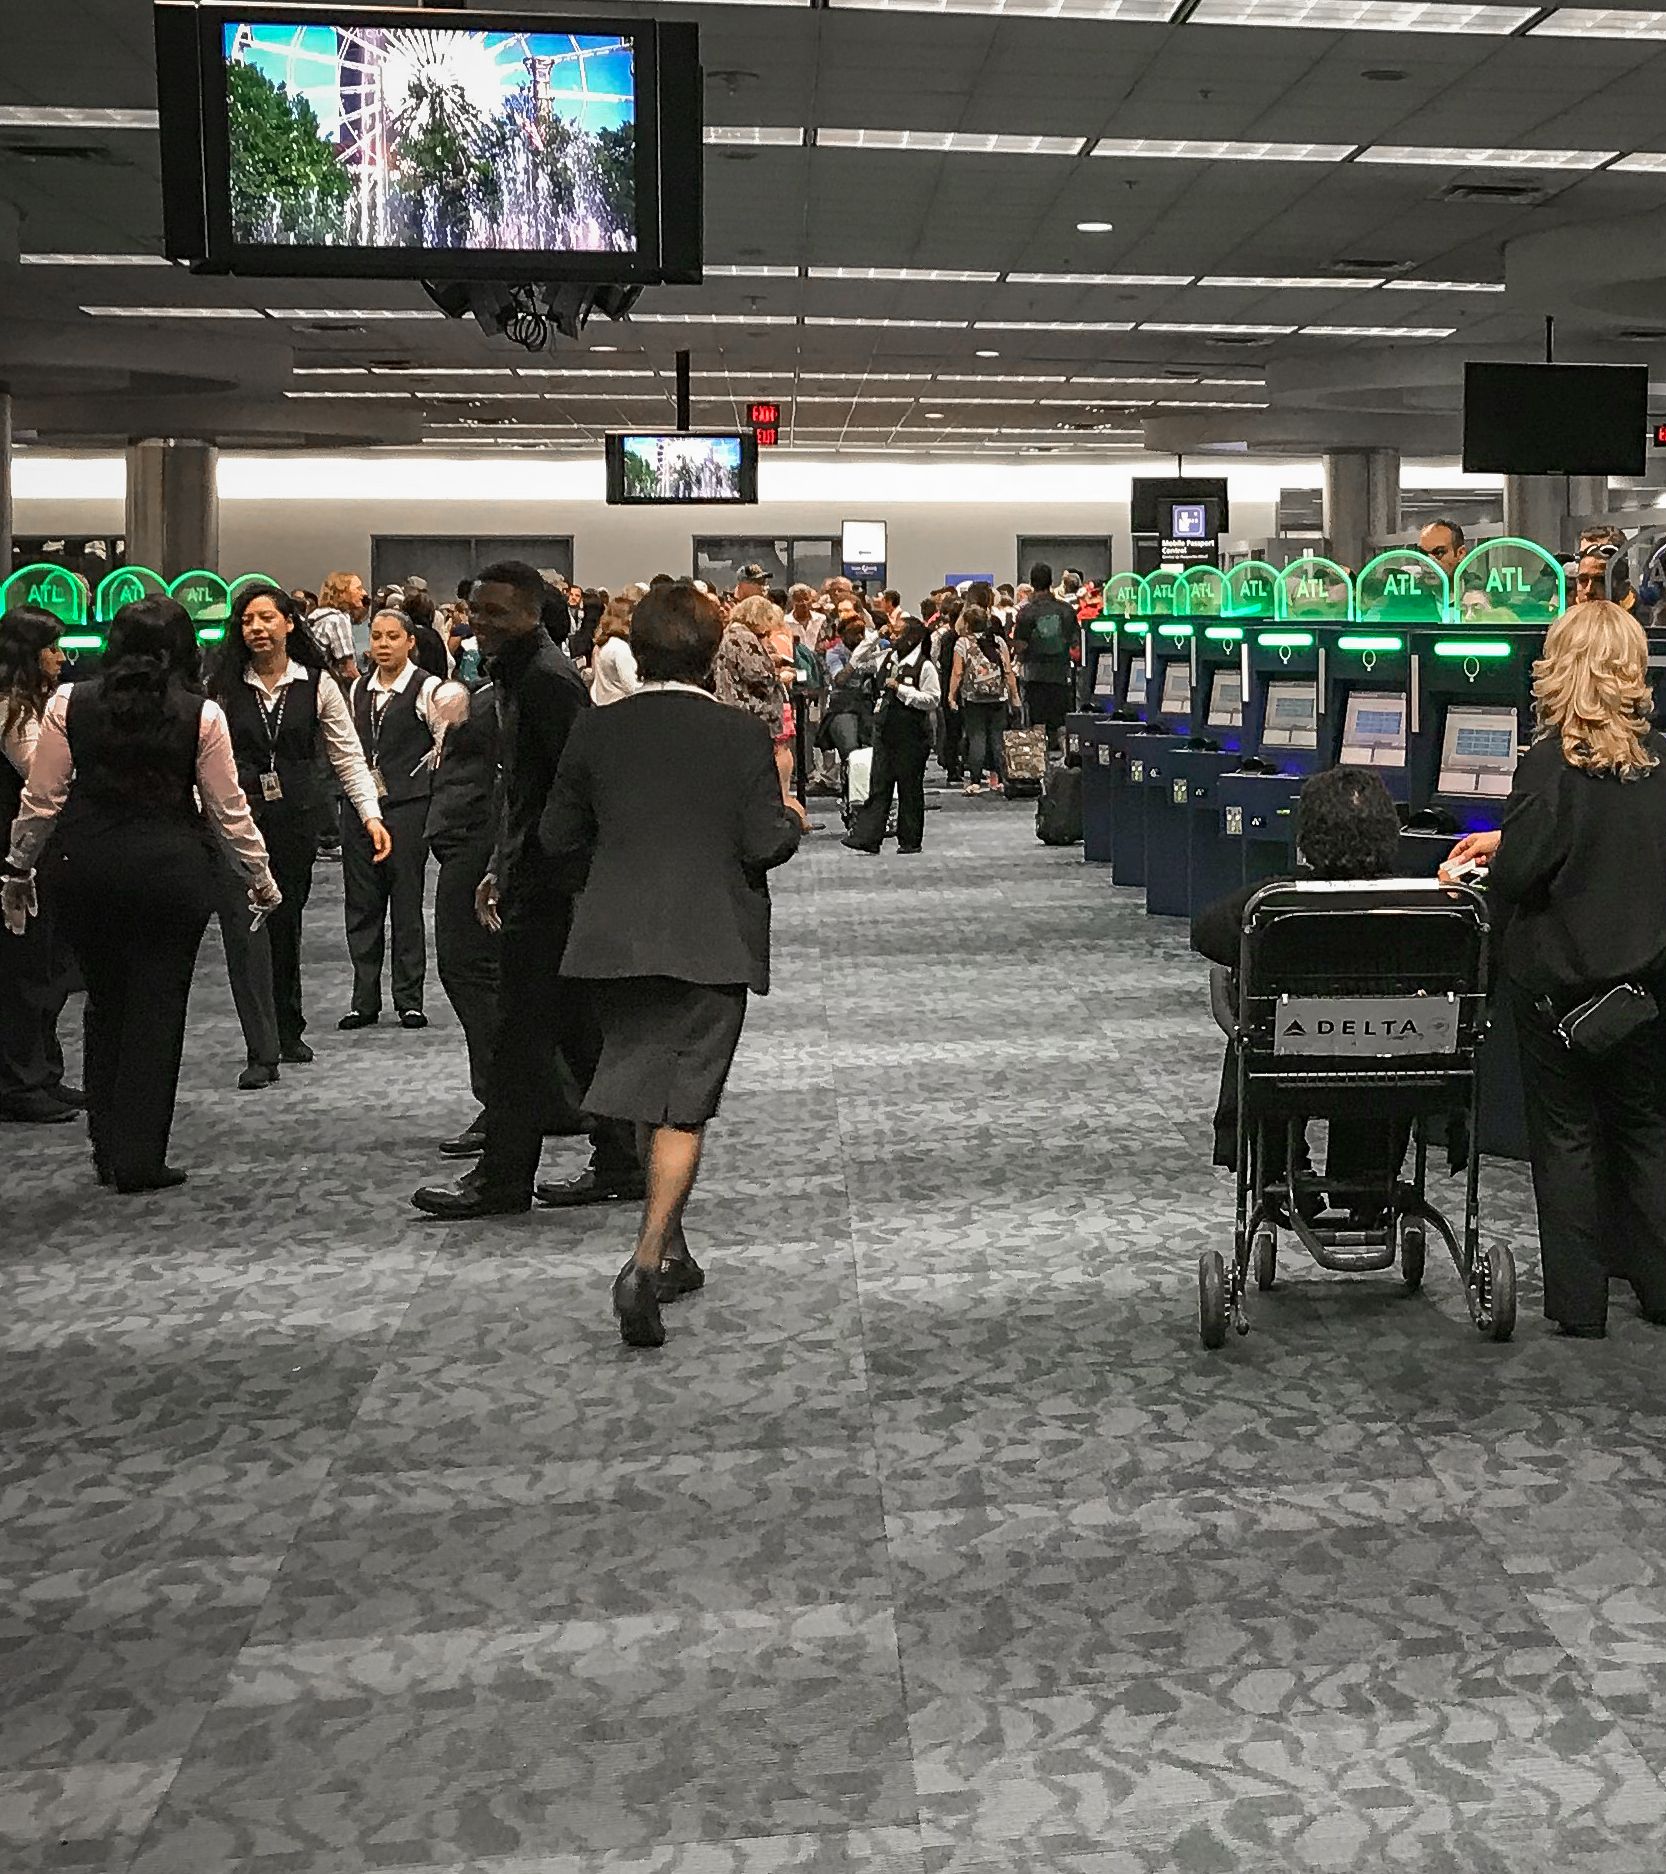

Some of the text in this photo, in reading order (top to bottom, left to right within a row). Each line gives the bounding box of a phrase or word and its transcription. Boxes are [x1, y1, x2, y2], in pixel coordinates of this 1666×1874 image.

[1239, 580, 1267, 597] ATL
[1296, 578, 1329, 598] ATL
[1383, 574, 1422, 596] ATL
[1486, 567, 1531, 593] ATL
[28, 585, 65, 603] ATL
[120, 586, 144, 602] AT
[187, 587, 213, 602] ATL
[1117, 587, 1137, 600] ATL
[1152, 584, 1175, 598] ATL
[1190, 583, 1215, 598] ATL
[1317, 1018, 1417, 1036] DELTA
